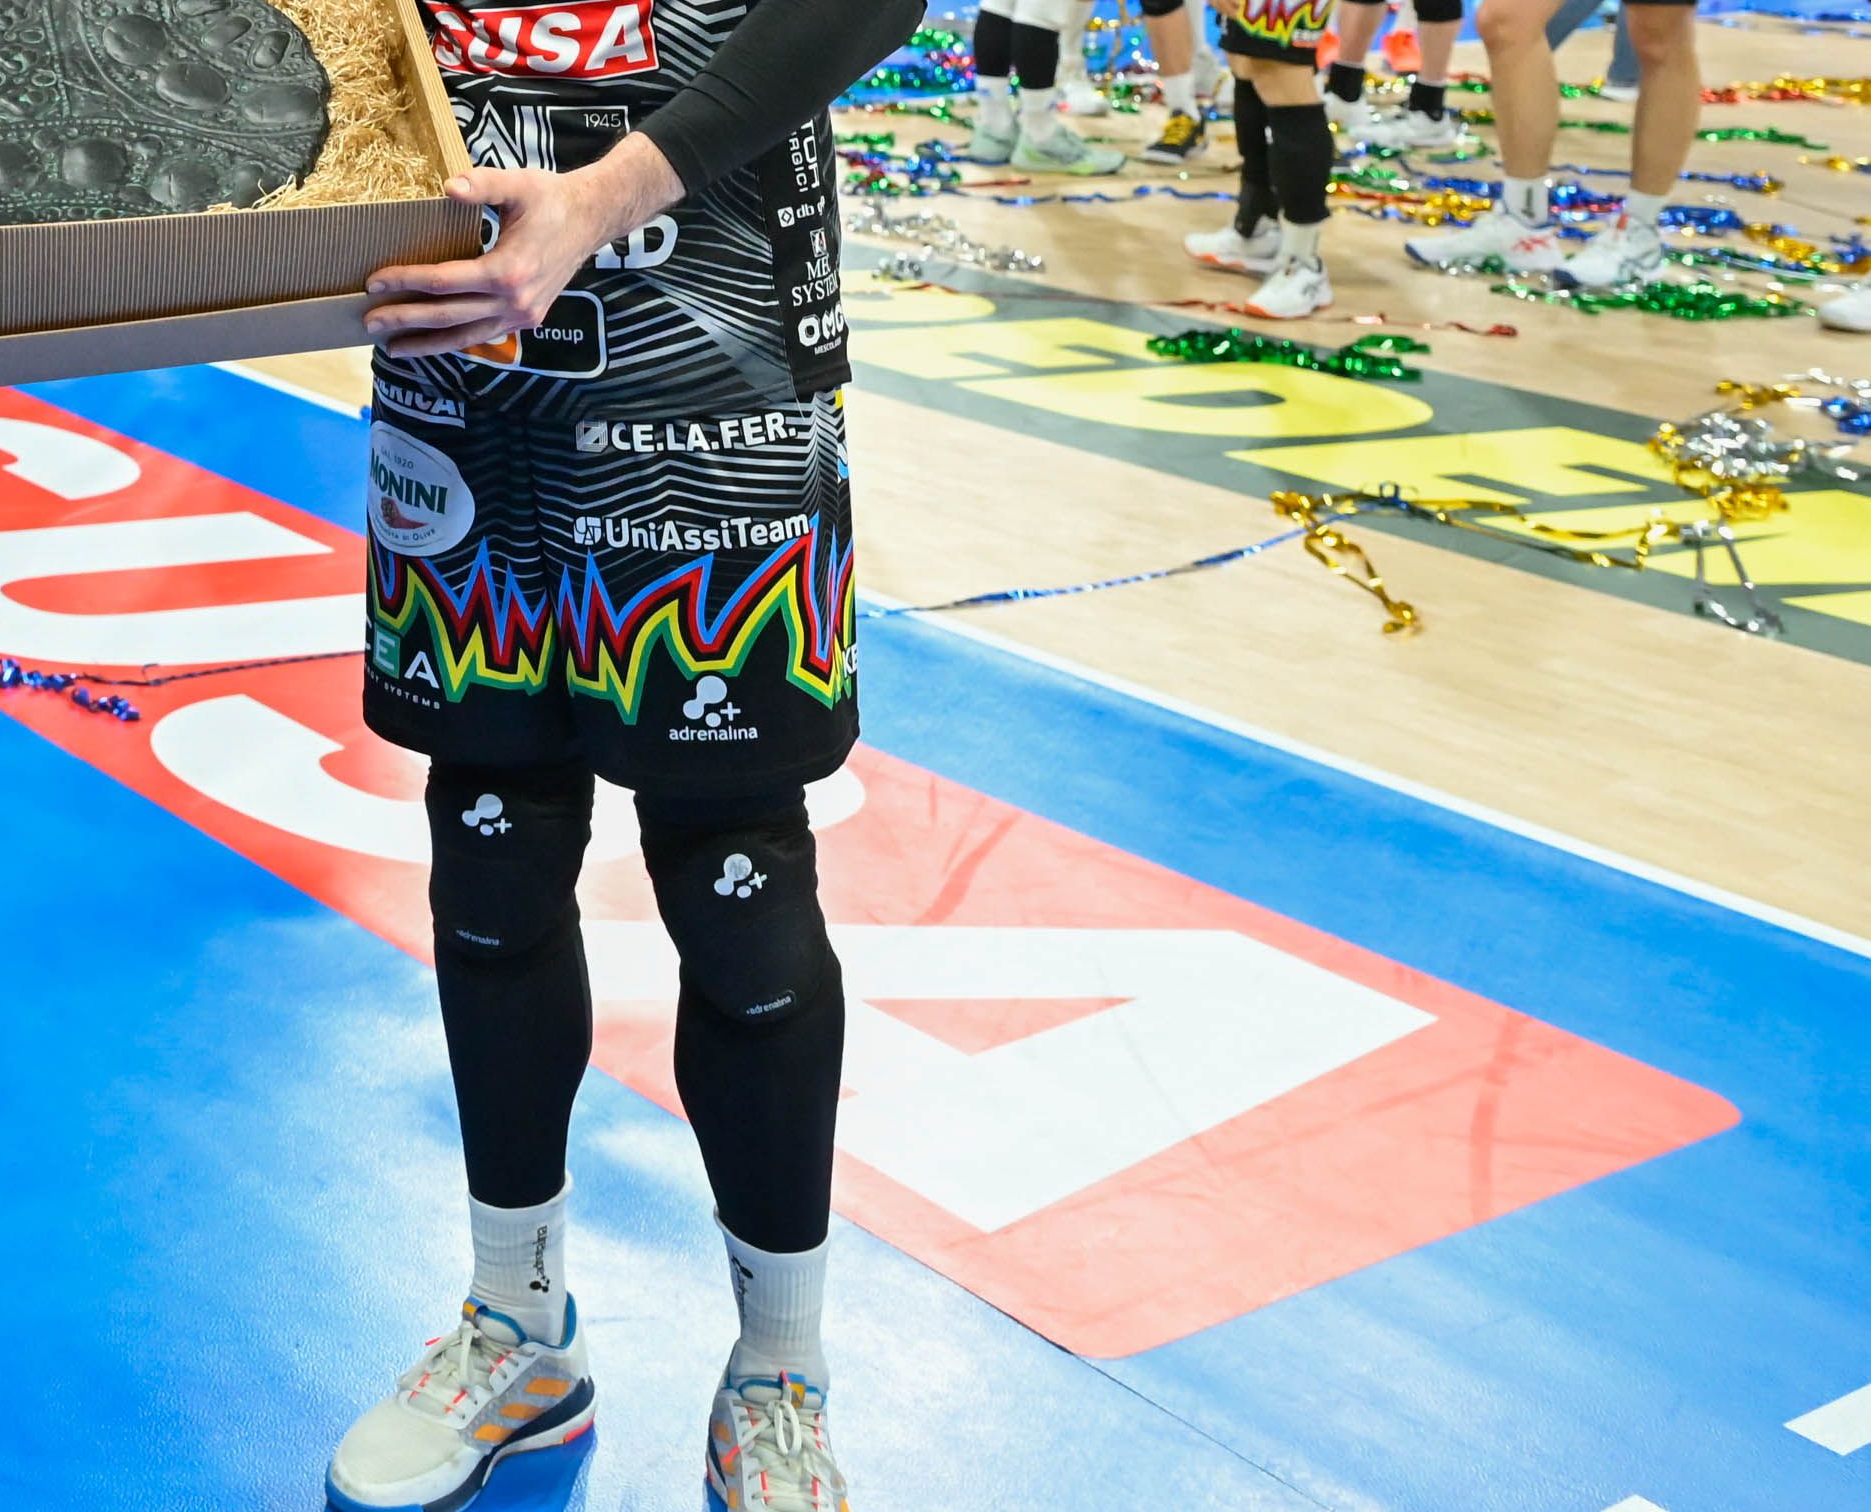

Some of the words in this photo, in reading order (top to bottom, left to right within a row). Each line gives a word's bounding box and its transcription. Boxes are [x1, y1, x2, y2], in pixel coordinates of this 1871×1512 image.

[433, 2, 650, 74] SUSA
[583, 113, 621, 128] 1945
[611, 412, 797, 453] CE.LA.FER.
[370, 448, 449, 515] MONINI
[394, 455, 414, 470] 1920
[605, 513, 811, 551] UniAssiTeam
[668, 724, 759, 742] adrenalina
